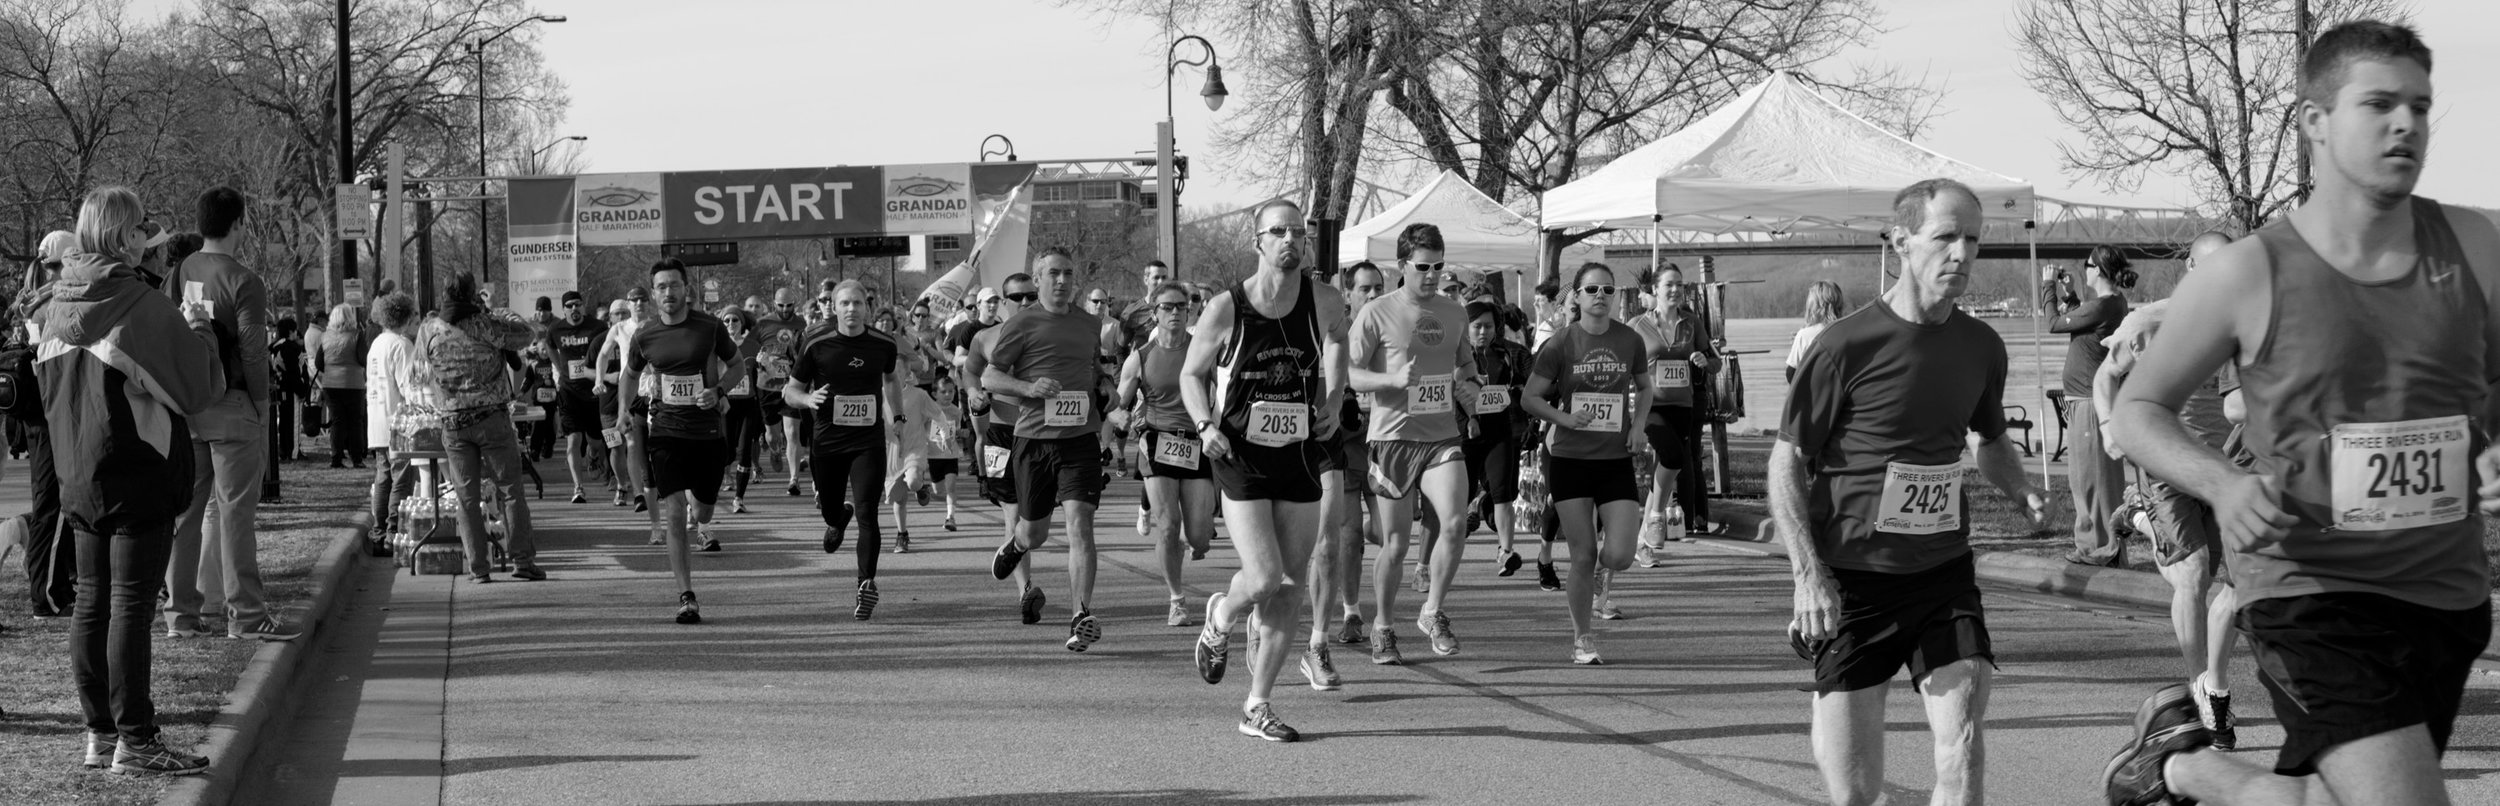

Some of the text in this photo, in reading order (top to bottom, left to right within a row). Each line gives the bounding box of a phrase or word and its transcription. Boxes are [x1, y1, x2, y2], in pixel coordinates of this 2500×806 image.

[694, 182, 853, 225] START
[886, 199, 967, 212] GRANDAD
[579, 208, 661, 223] GRANDAD
[887, 211, 958, 221] HALF MARATHON
[580, 221, 652, 232] HALF MARATHON
[510, 241, 574, 255] GUNDERSEN
[1573, 363, 1627, 374] RUN MPLS
[1664, 367, 1685, 379] 2116
[671, 383, 695, 397] 2417
[1418, 385, 1446, 402] 2458
[1481, 392, 1504, 406] 2050
[842, 403, 868, 417] 2219
[1056, 400, 1082, 416] 2221
[1582, 402, 1613, 420] 2457
[1260, 414, 1298, 435] 2035
[2342, 430, 2464, 449] THREE RIVERS 5K RUN
[1164, 441, 1192, 459] 2289
[1893, 471, 1918, 482] THREE
[1920, 473, 1945, 482] RIVERS
[1952, 469, 1961, 478] RUN
[2367, 447, 2446, 498] 2431
[1900, 482, 1952, 514] 2425
